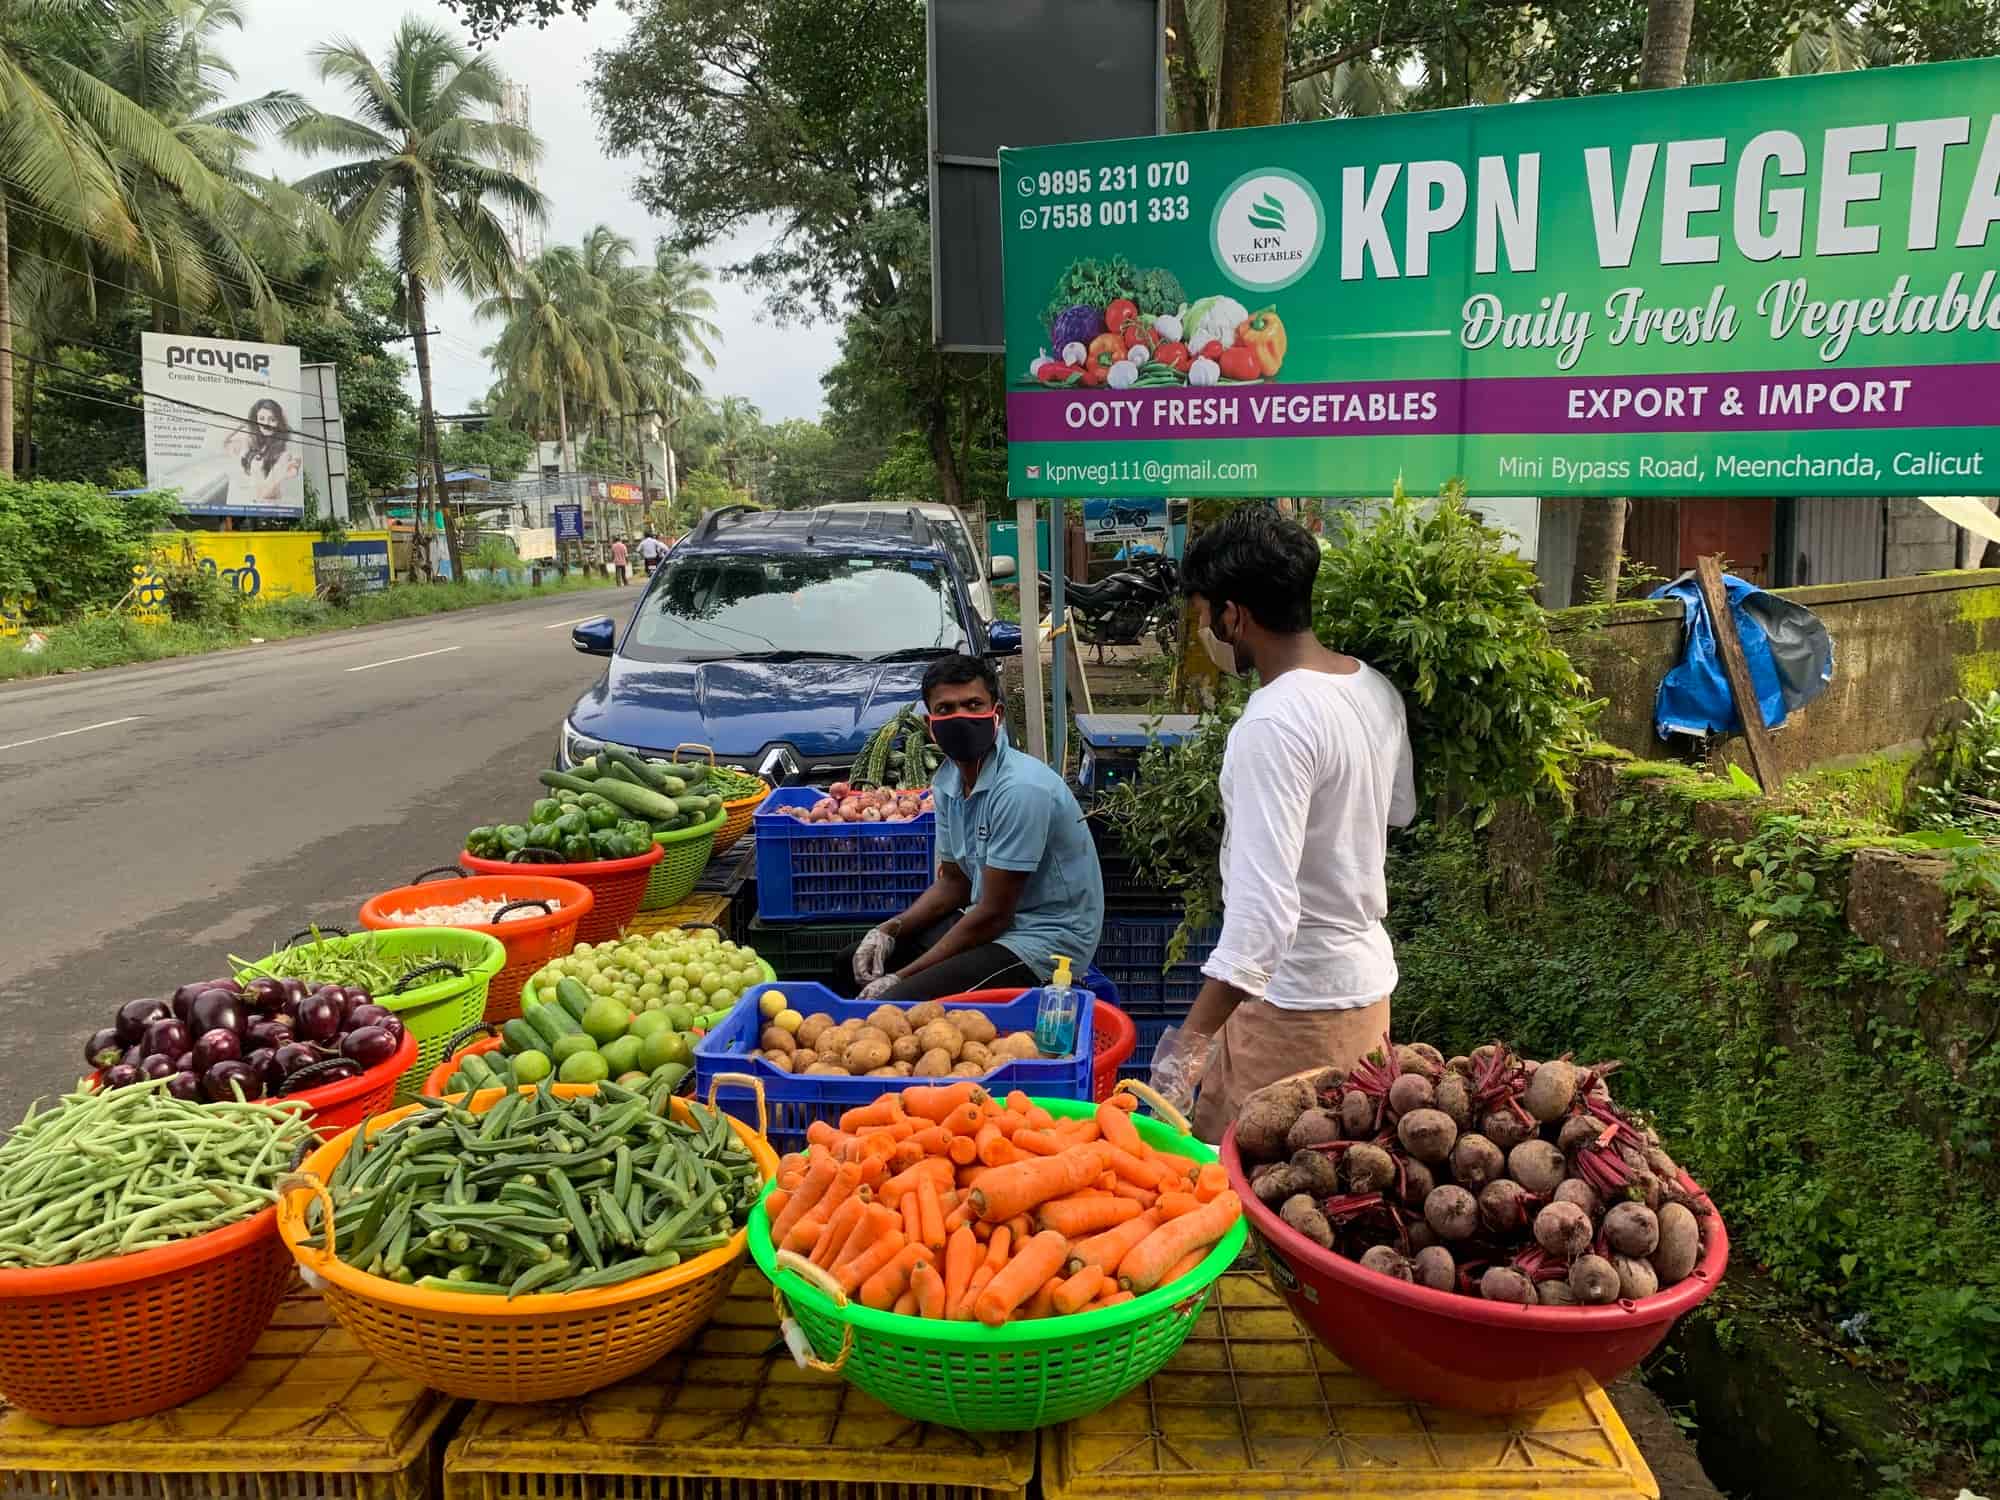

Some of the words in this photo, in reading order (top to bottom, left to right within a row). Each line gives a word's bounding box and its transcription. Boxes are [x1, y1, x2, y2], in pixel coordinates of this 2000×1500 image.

[1038, 168, 1092, 197] 9895
[1098, 165, 1138, 192] 231
[1147, 160, 1190, 188] 070
[1039, 203, 1093, 230] 7558
[1099, 200, 1138, 226] 001
[1147, 195, 1190, 223] 333
[1340, 152, 1541, 281] KPN
[1232, 249, 1303, 264] VEGETABLES
[1253, 236, 1281, 249] KPN
[1460, 292, 1594, 370] Daily
[1604, 285, 1740, 346] Fresh
[1065, 400, 1144, 429] OOTY
[1152, 397, 1240, 427] FRESH
[1248, 391, 1438, 424] VEGETABLES
[1567, 386, 1708, 418] EXPORT
[1719, 387, 1745, 416] &
[1758, 380, 1912, 415] IMPORT
[1046, 460, 1258, 483] kpnveg111@gmail.com
[1499, 456, 1543, 479] Mini
[1551, 456, 1631, 483] Bypass
[1639, 455, 1706, 482] Road,
[1715, 453, 1882, 481] Meenchanda,
[1892, 450, 1984, 476] Calicut
